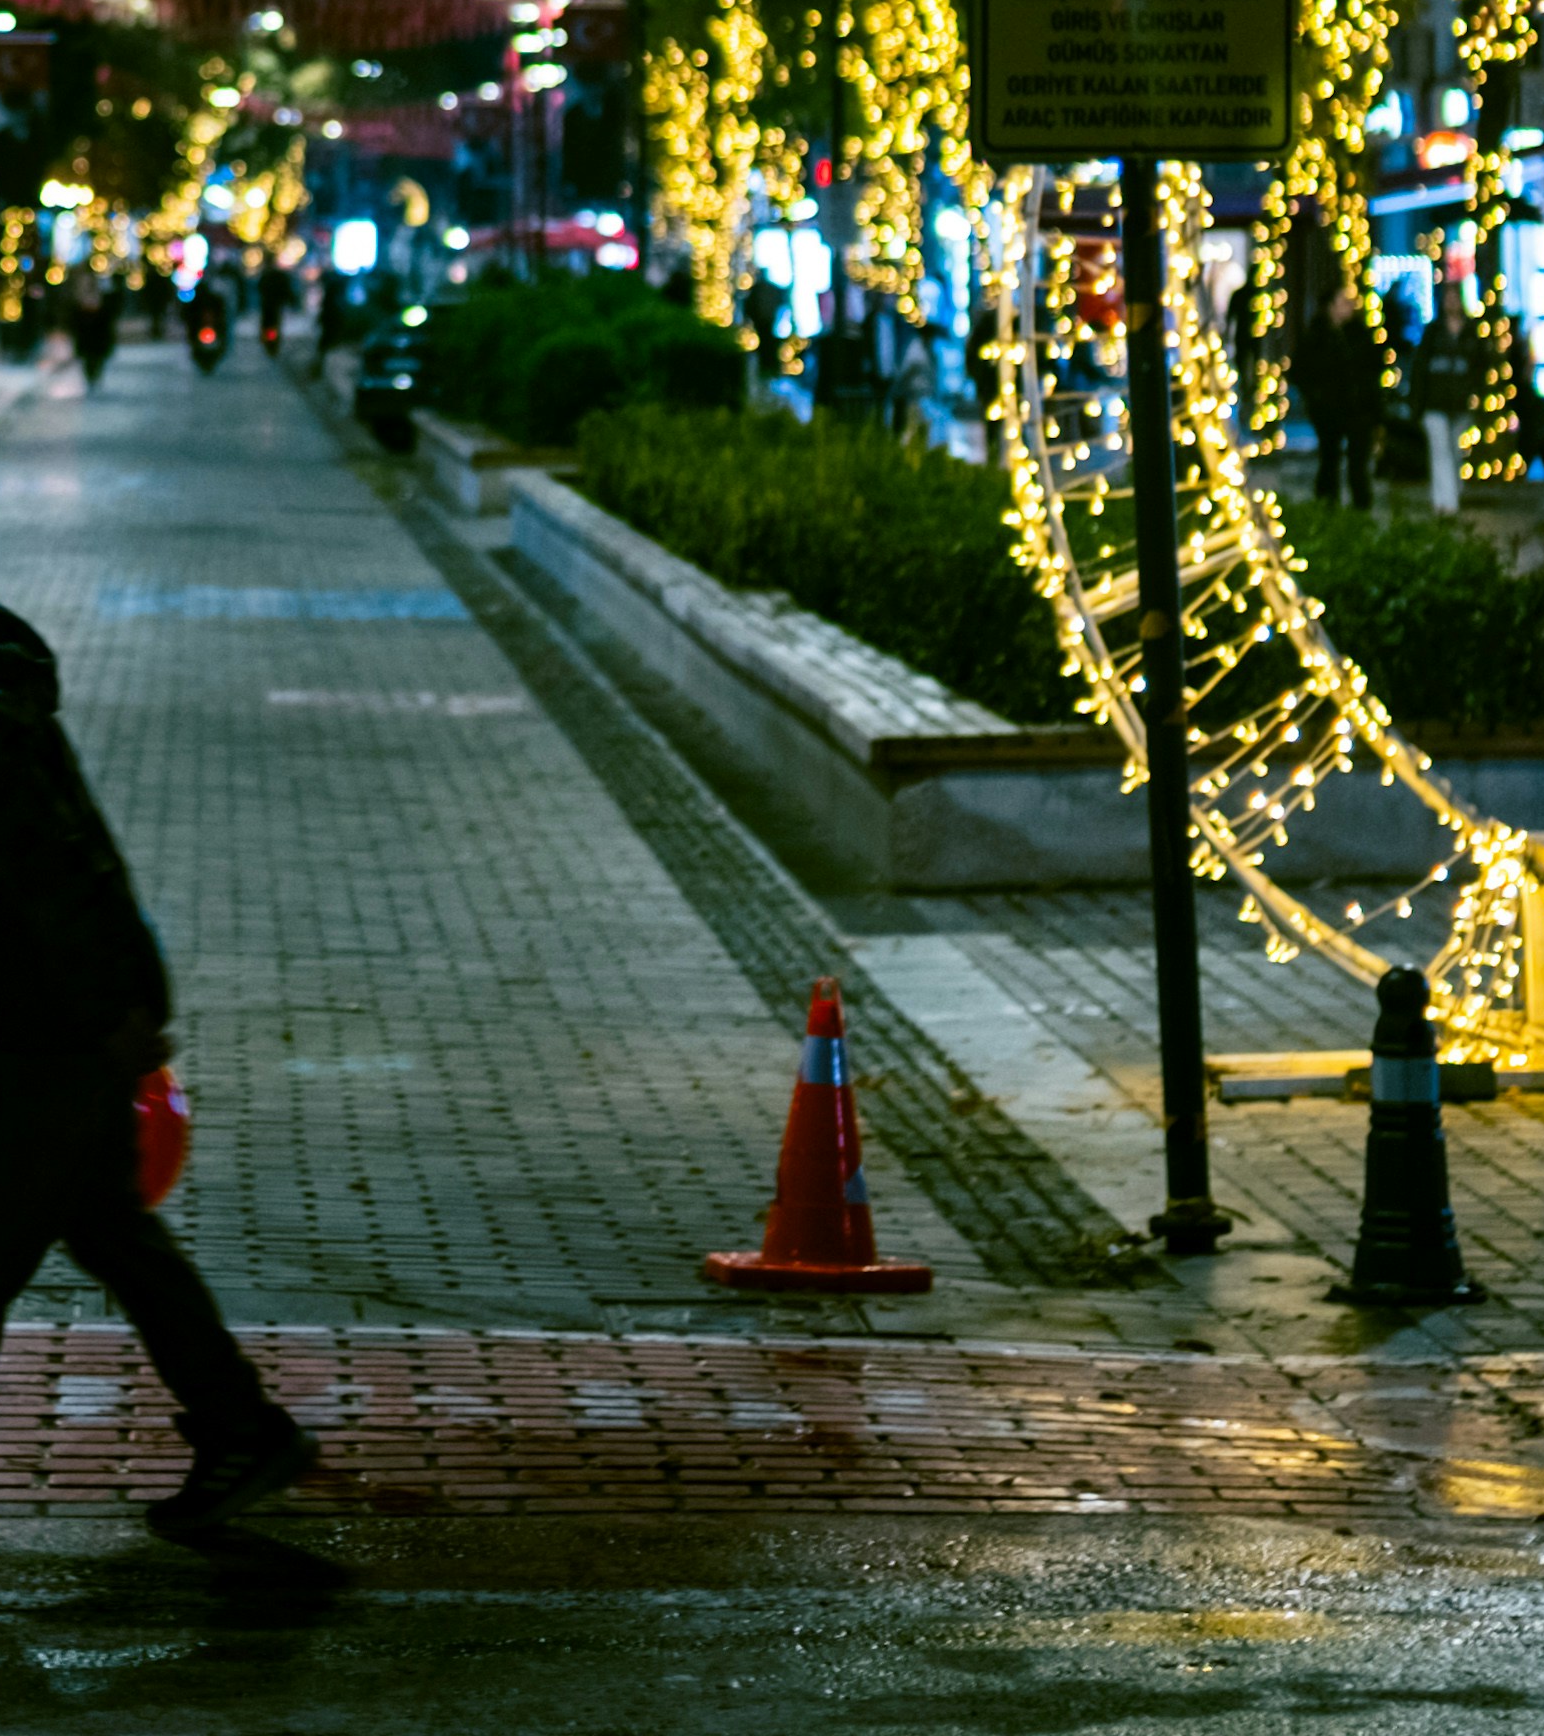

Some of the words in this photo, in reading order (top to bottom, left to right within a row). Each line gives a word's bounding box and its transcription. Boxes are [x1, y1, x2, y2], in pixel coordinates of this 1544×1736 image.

[1050, 6, 1102, 33] GİRİŞ
[1106, 10, 1132, 31] VE
[1136, 9, 1226, 33] ÇIKIŞLAR
[1047, 39, 1119, 65] GÜMÜŞ
[1123, 41, 1228, 64] SOKAKTAN
[1006, 71, 1077, 96] GERİYE
[1082, 75, 1150, 96] KALAN
[1153, 74, 1269, 96] SAATLERDE
[1002, 107, 1056, 130] ARAÇ
[1061, 103, 1164, 127] TRAFİĞİNE
[1169, 106, 1273, 127] KAPALIDIR
